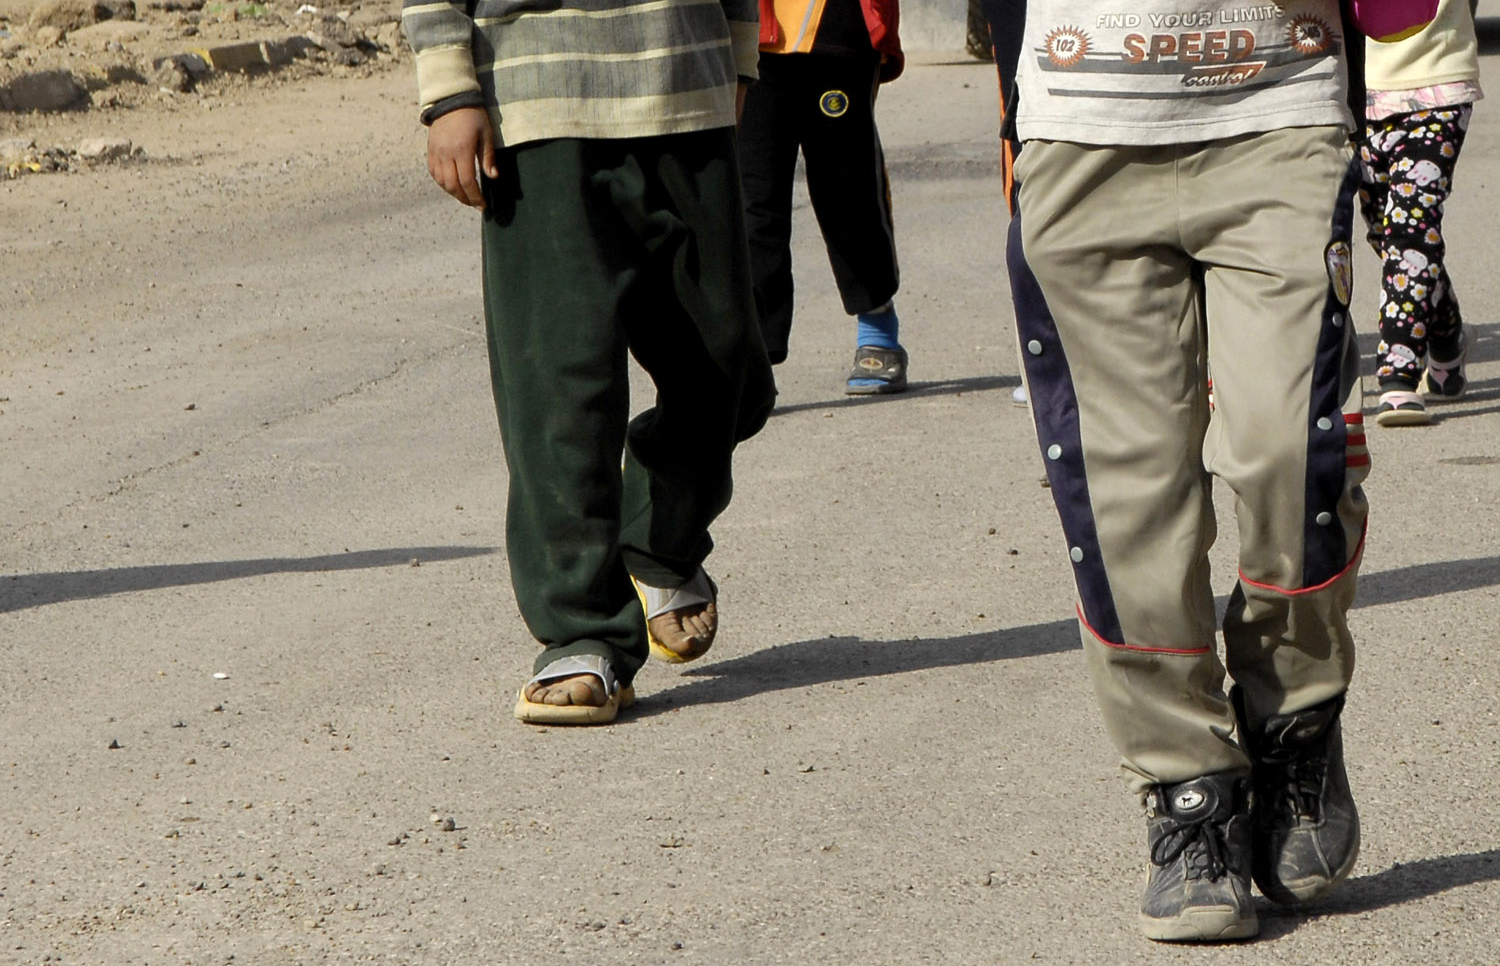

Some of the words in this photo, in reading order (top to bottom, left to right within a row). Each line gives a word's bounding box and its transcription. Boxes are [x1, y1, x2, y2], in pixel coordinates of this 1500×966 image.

[1096, 13, 1142, 29] FIND
[1150, 11, 1213, 28] YOUR
[1220, 4, 1287, 24] LIMITS
[1056, 38, 1076, 53] 102
[1122, 28, 1255, 64] SPEED
